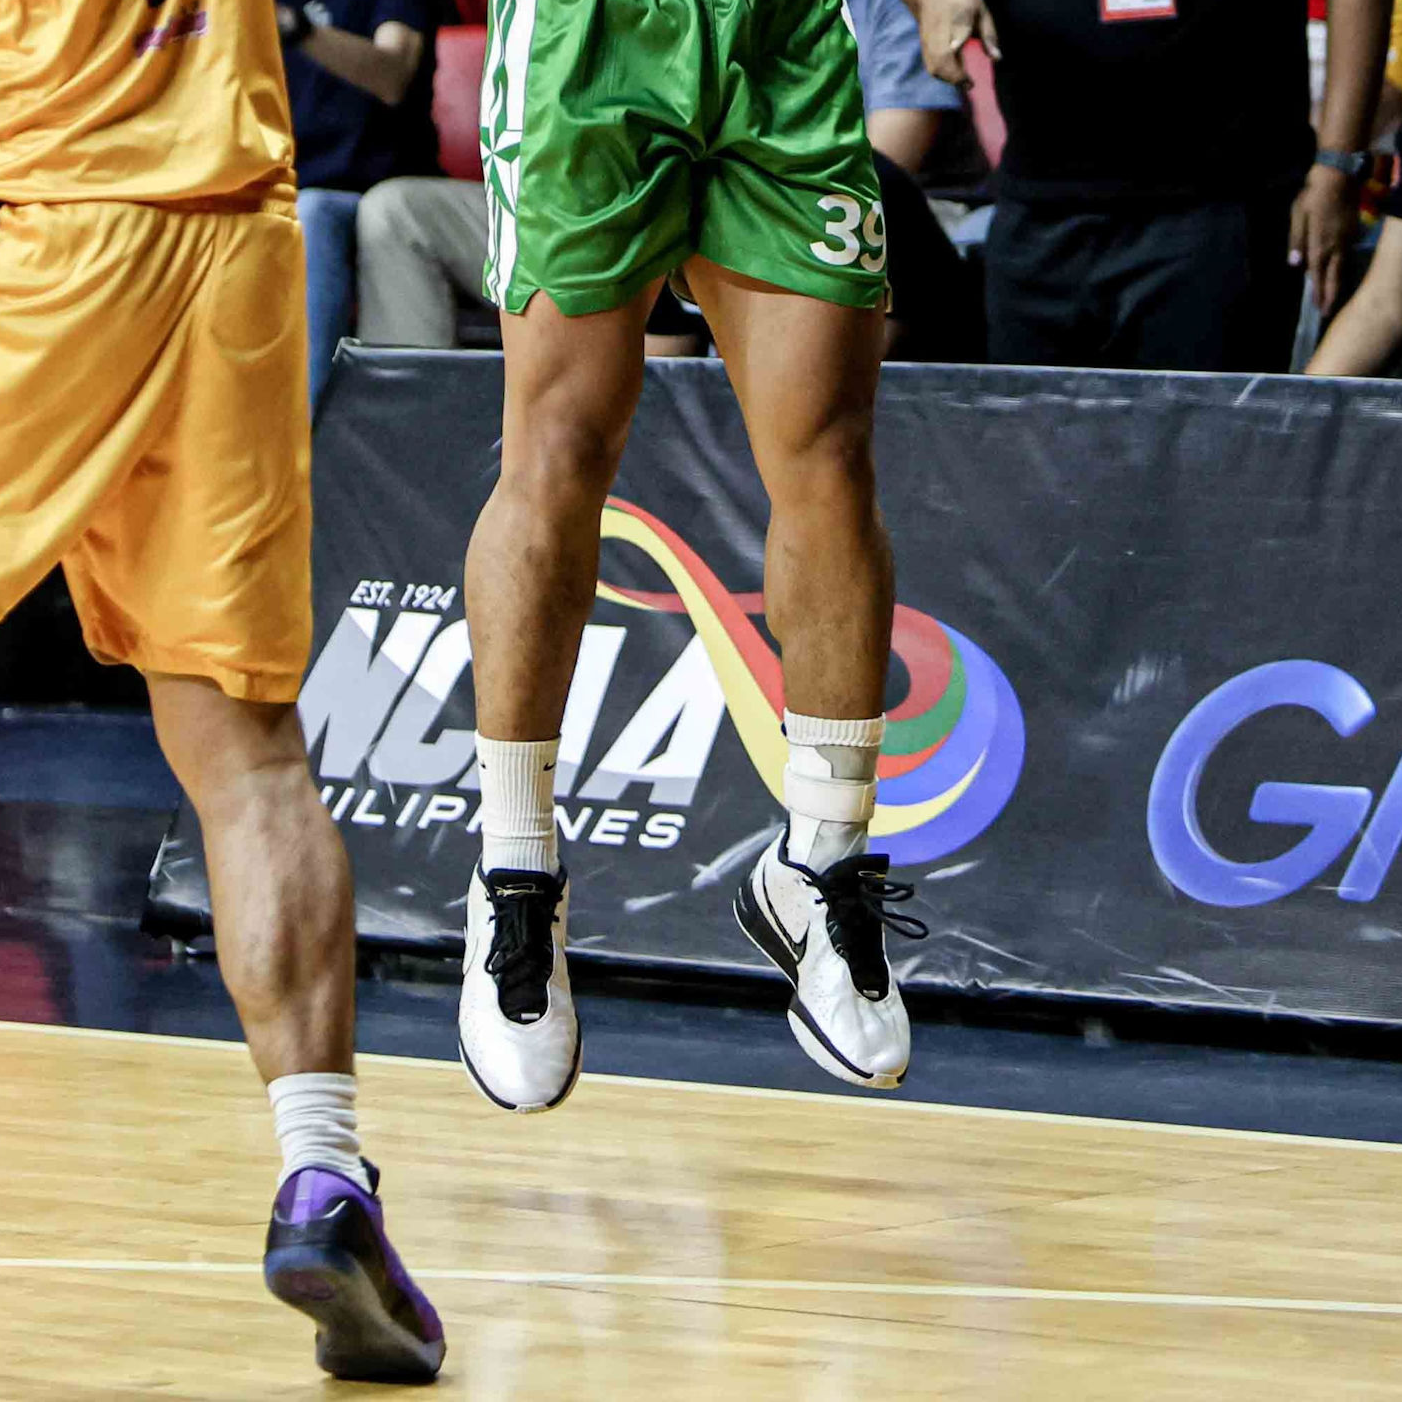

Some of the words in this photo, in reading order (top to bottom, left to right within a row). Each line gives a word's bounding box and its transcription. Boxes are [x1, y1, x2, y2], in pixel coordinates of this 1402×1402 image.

[809, 194, 887, 273] 39
[350, 580, 394, 607] EST.
[399, 583, 457, 610] 1924
